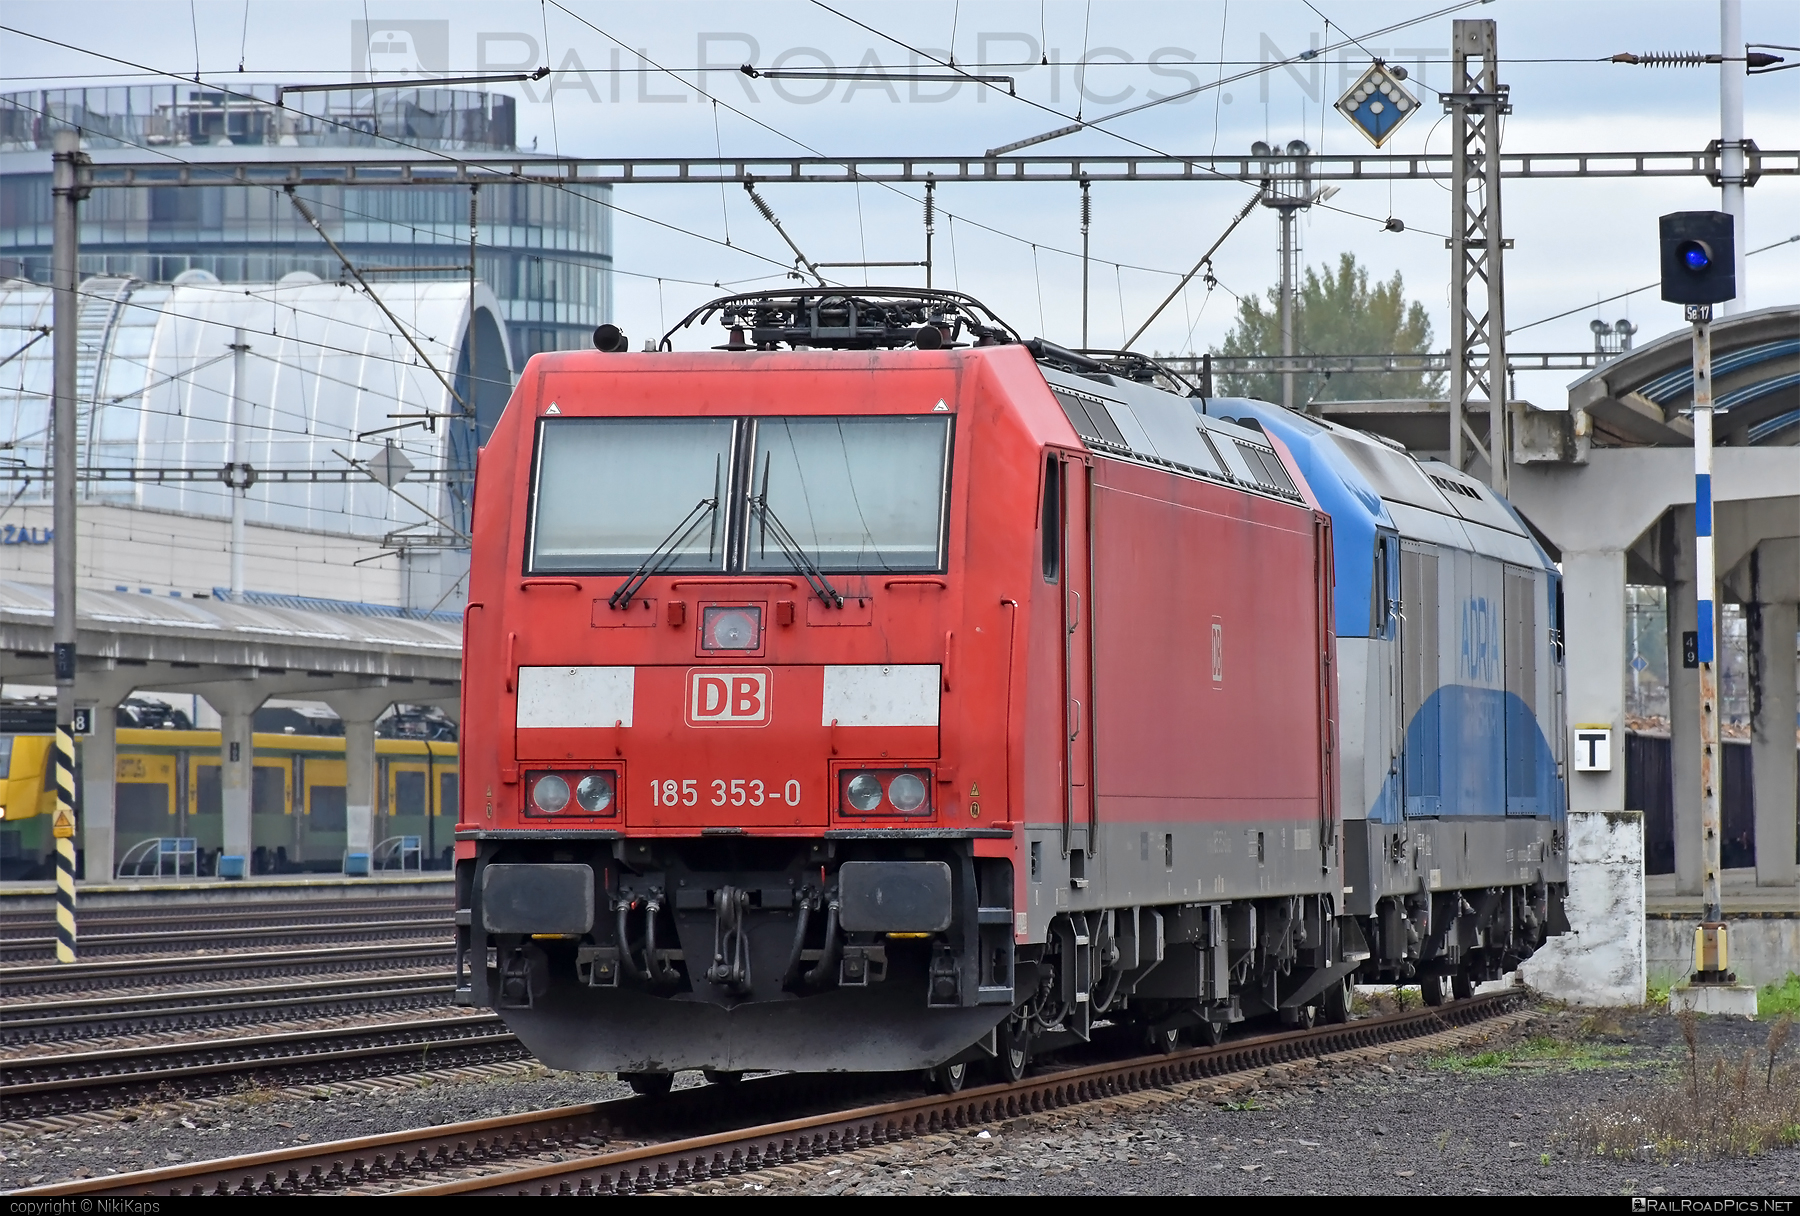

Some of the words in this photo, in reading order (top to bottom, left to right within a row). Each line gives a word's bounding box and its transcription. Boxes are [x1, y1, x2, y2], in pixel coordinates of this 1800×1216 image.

[1687, 306, 1698, 320] Se
[1700, 305, 1710, 320] 17
[0, 524, 55, 545] ŽALK
[1461, 596, 1500, 685] ADRIA
[697, 677, 761, 717] DB
[76, 715, 86, 731] 8
[1578, 733, 1607, 768] T
[650, 779, 698, 807] 185
[710, 779, 801, 807] 353-0
